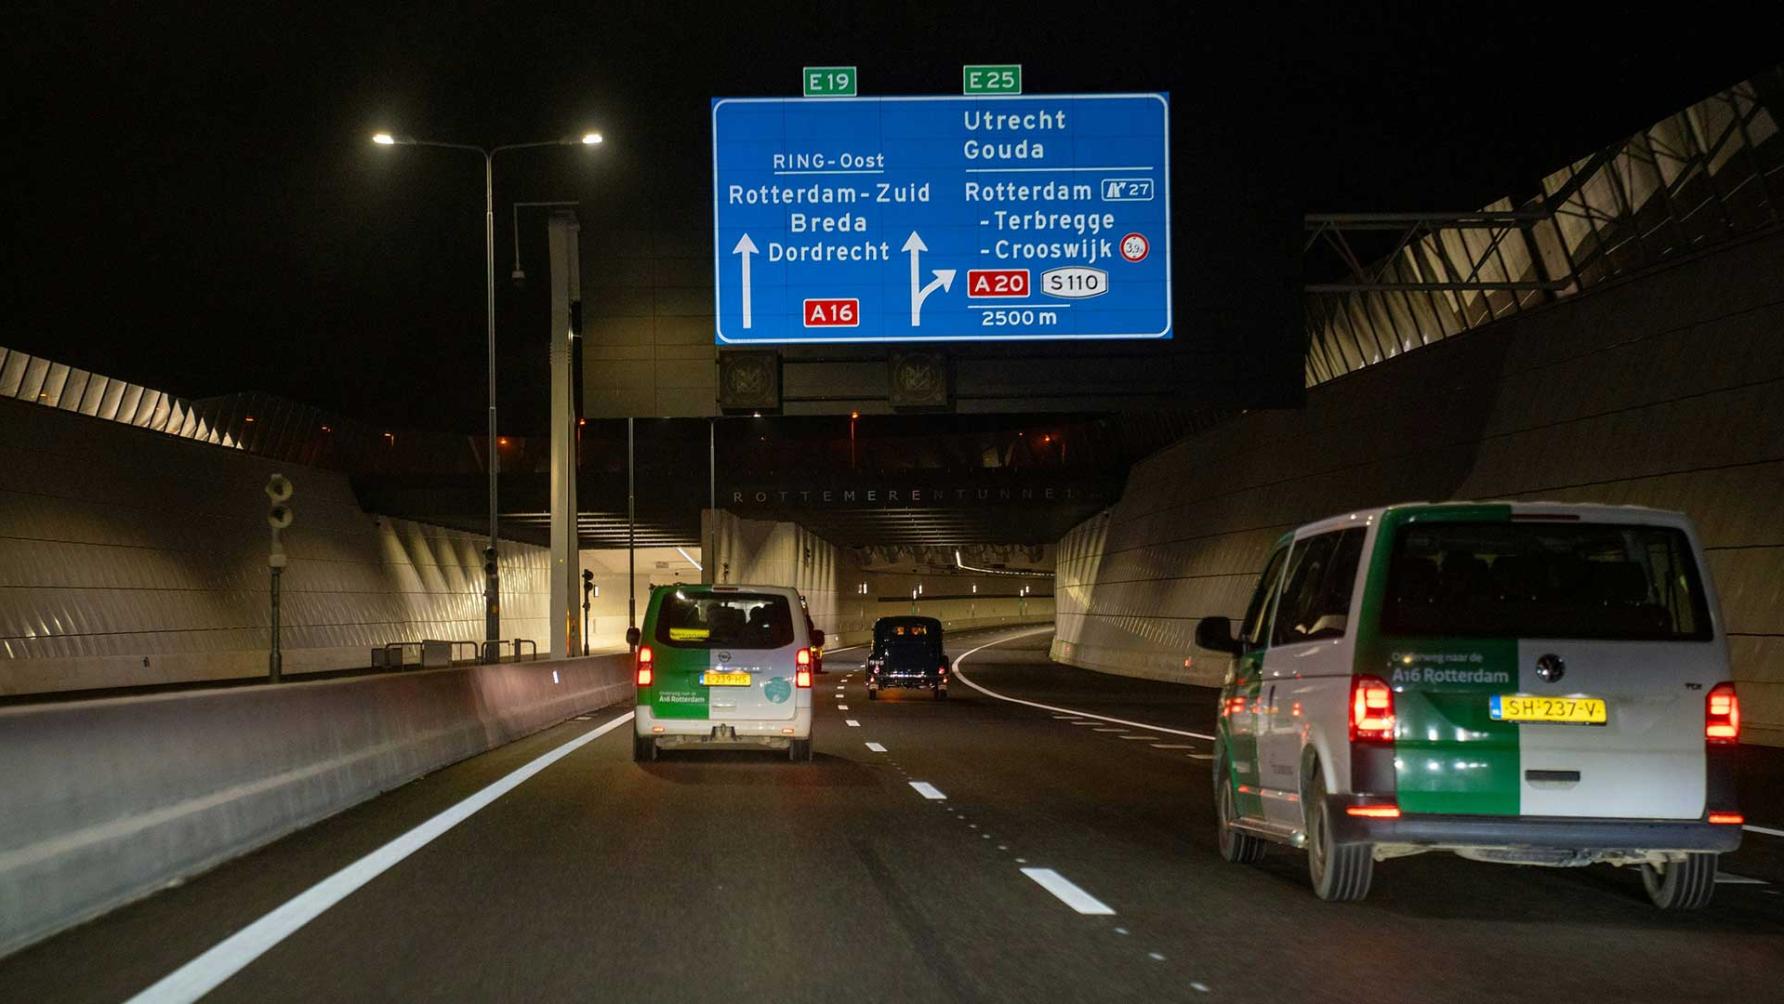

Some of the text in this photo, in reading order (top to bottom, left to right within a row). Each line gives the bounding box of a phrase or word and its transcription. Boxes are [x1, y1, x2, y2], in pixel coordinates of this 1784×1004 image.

[964, 110, 1066, 130] Utrecht
[964, 139, 1044, 159] Gouda
[773, 153, 884, 168] RING-Oost
[729, 182, 930, 204] Rotterdam-Zuid
[965, 181, 1092, 201] Rotterdam
[1129, 183, 1149, 196] 27
[791, 212, 867, 232] Breda
[769, 241, 890, 262] Dordrecht
[982, 311, 1057, 326] 2500 m
[1392, 652, 1445, 664] Oerweg
[1392, 668, 1509, 684] A16 Rotterdam
